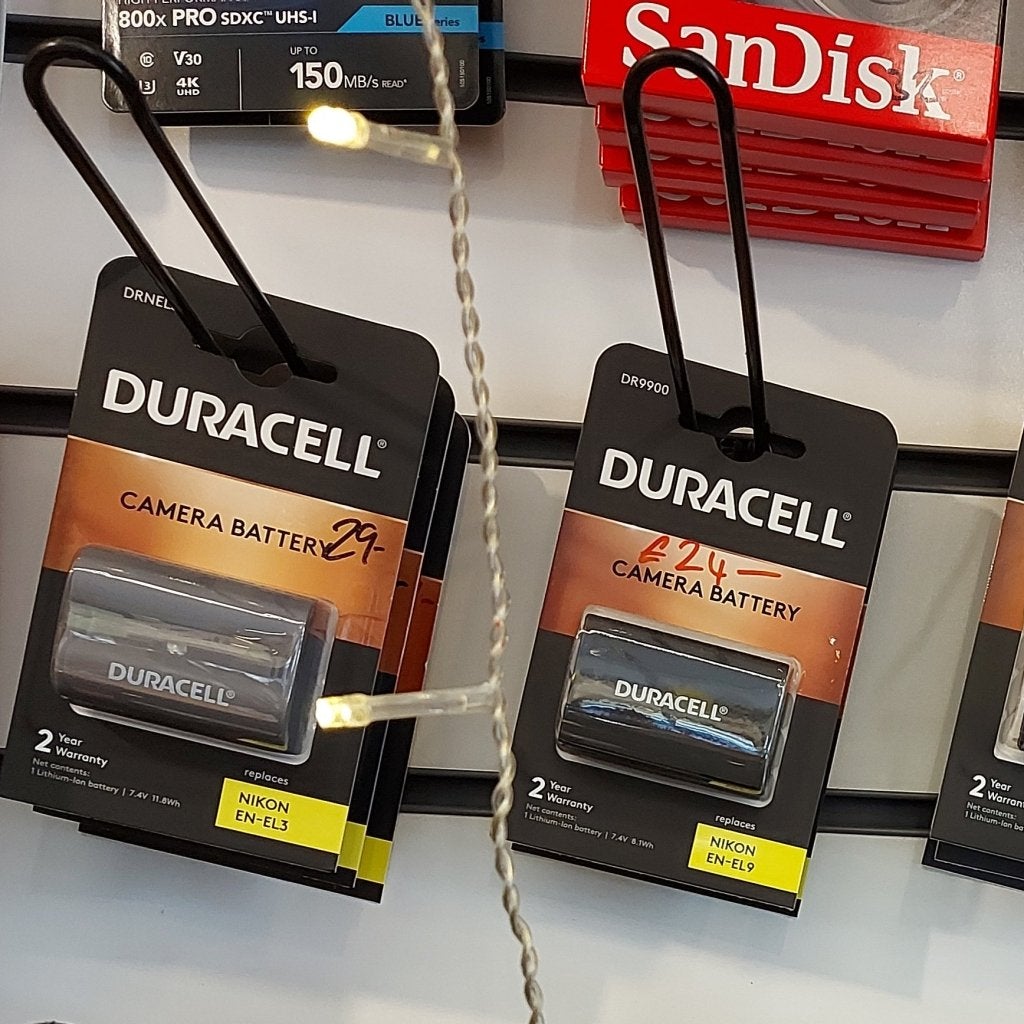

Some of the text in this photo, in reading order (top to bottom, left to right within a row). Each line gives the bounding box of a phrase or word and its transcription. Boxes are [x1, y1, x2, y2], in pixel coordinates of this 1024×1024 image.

[118, 10, 167, 28] 800x
[172, 8, 217, 26] PRO
[275, 10, 317, 24] UHS-I
[173, 51, 202, 66] V30
[290, 46, 318, 56] UP TO
[621, 2, 951, 121] SanDisk
[176, 77, 200, 88] 4K
[620, 372, 670, 396] DR9900
[102, 368, 381, 479] DURACELL
[599, 448, 846, 549] DURACELL
[120, 491, 332, 559] CAMERA BATTERY
[612, 560, 801, 623] CAMERA BATTERY
[107, 661, 230, 708] DURACELL
[614, 679, 722, 722] DURACELL
[58, 732, 83, 748] Year
[55, 745, 108, 769] Warranty
[243, 768, 289, 786] replaces
[549, 780, 572, 794] Year
[989, 778, 1012, 793] Year
[238, 792, 290, 815] NIKON
[547, 791, 594, 813] Warranty
[235, 810, 288, 832] EN-EL3
[715, 813, 756, 831] replaces
[710, 836, 756, 857] NIKON
[706, 852, 755, 873] EN-EL9
